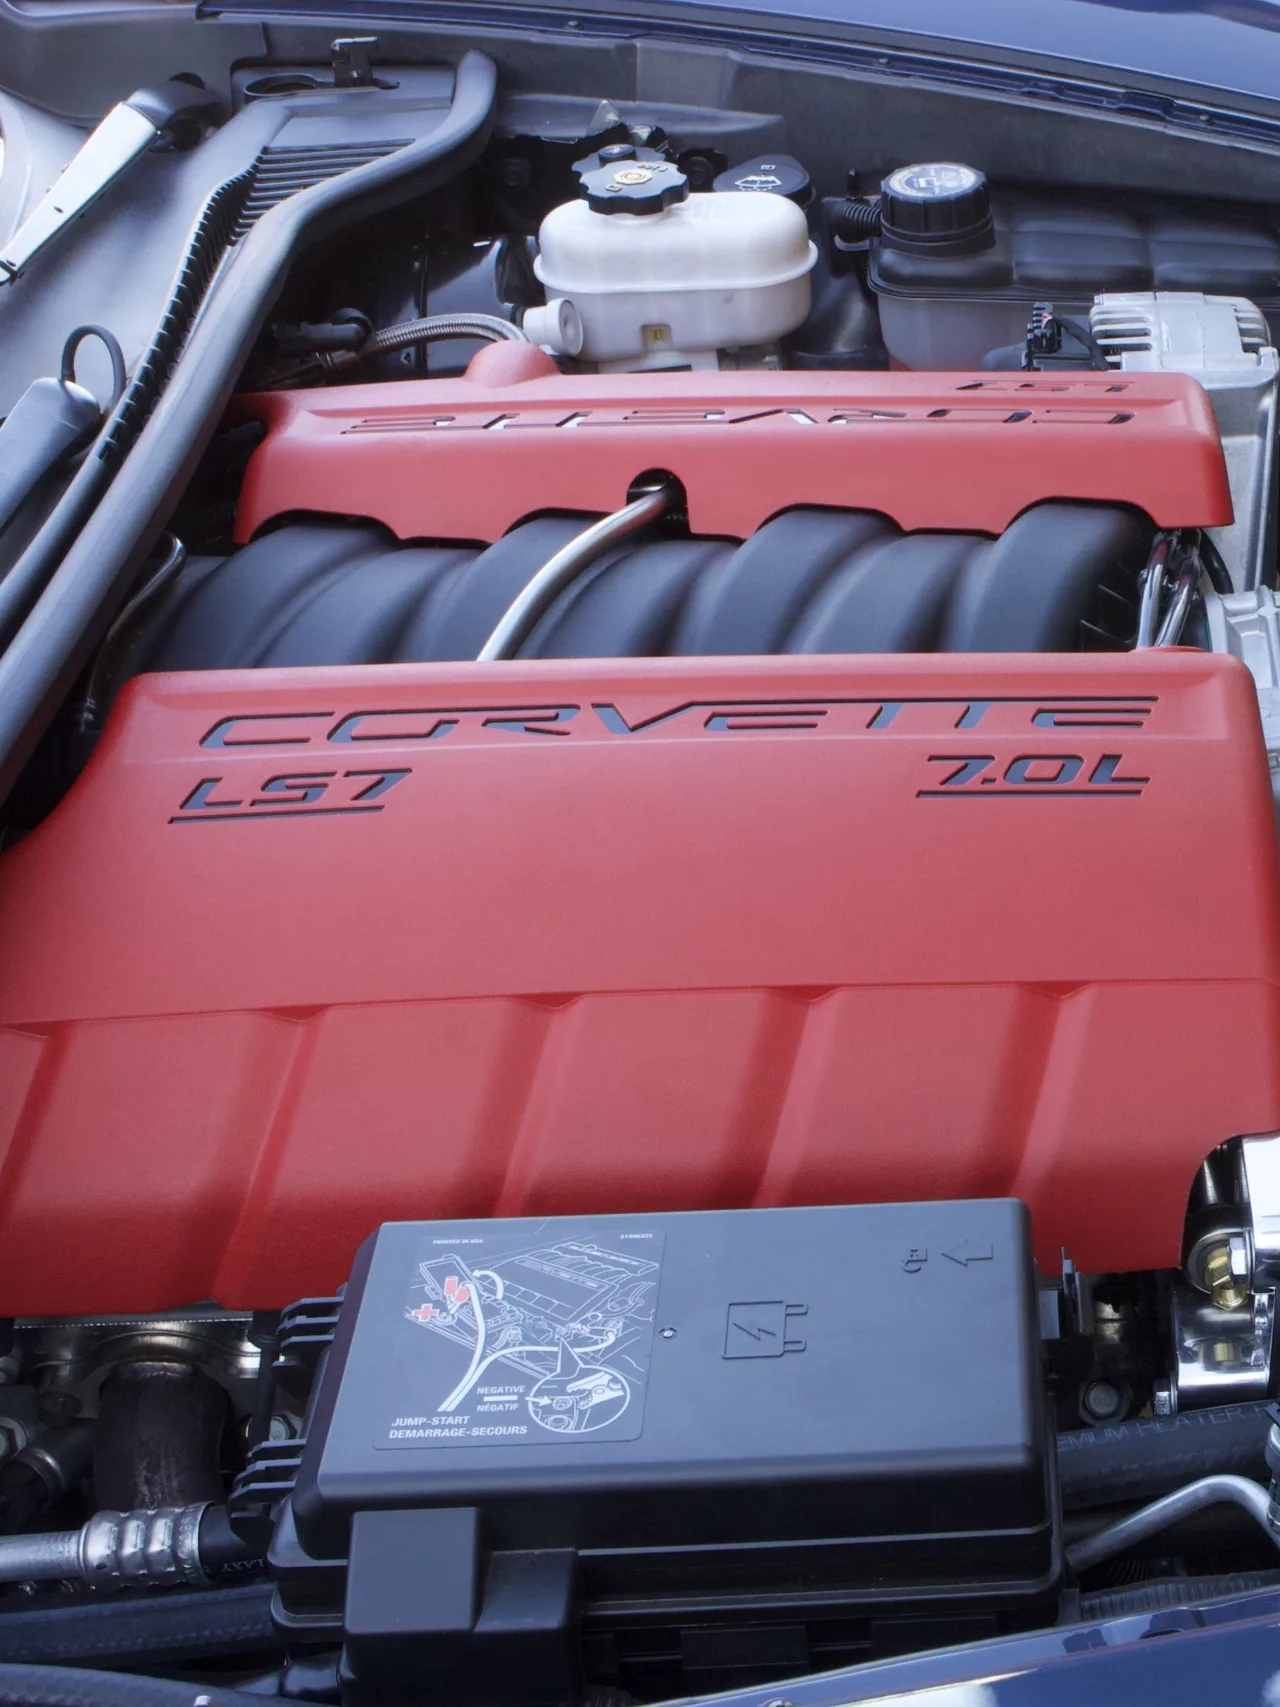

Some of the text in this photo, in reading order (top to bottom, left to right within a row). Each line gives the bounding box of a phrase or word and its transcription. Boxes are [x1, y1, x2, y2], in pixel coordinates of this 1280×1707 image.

[341, 407, 1135, 434] CORVETTE
[199, 695, 1160, 750] CORVETTE
[925, 754, 1151, 787] 7.0L
[178, 768, 413, 811] LS7
[477, 1385, 526, 1394] NEGATIVE
[389, 1425, 528, 1439] DEMARRAGE-SECOURS
[391, 1415, 470, 1427] JUMP-START
[1136, 1407, 1246, 1437] HEATER
